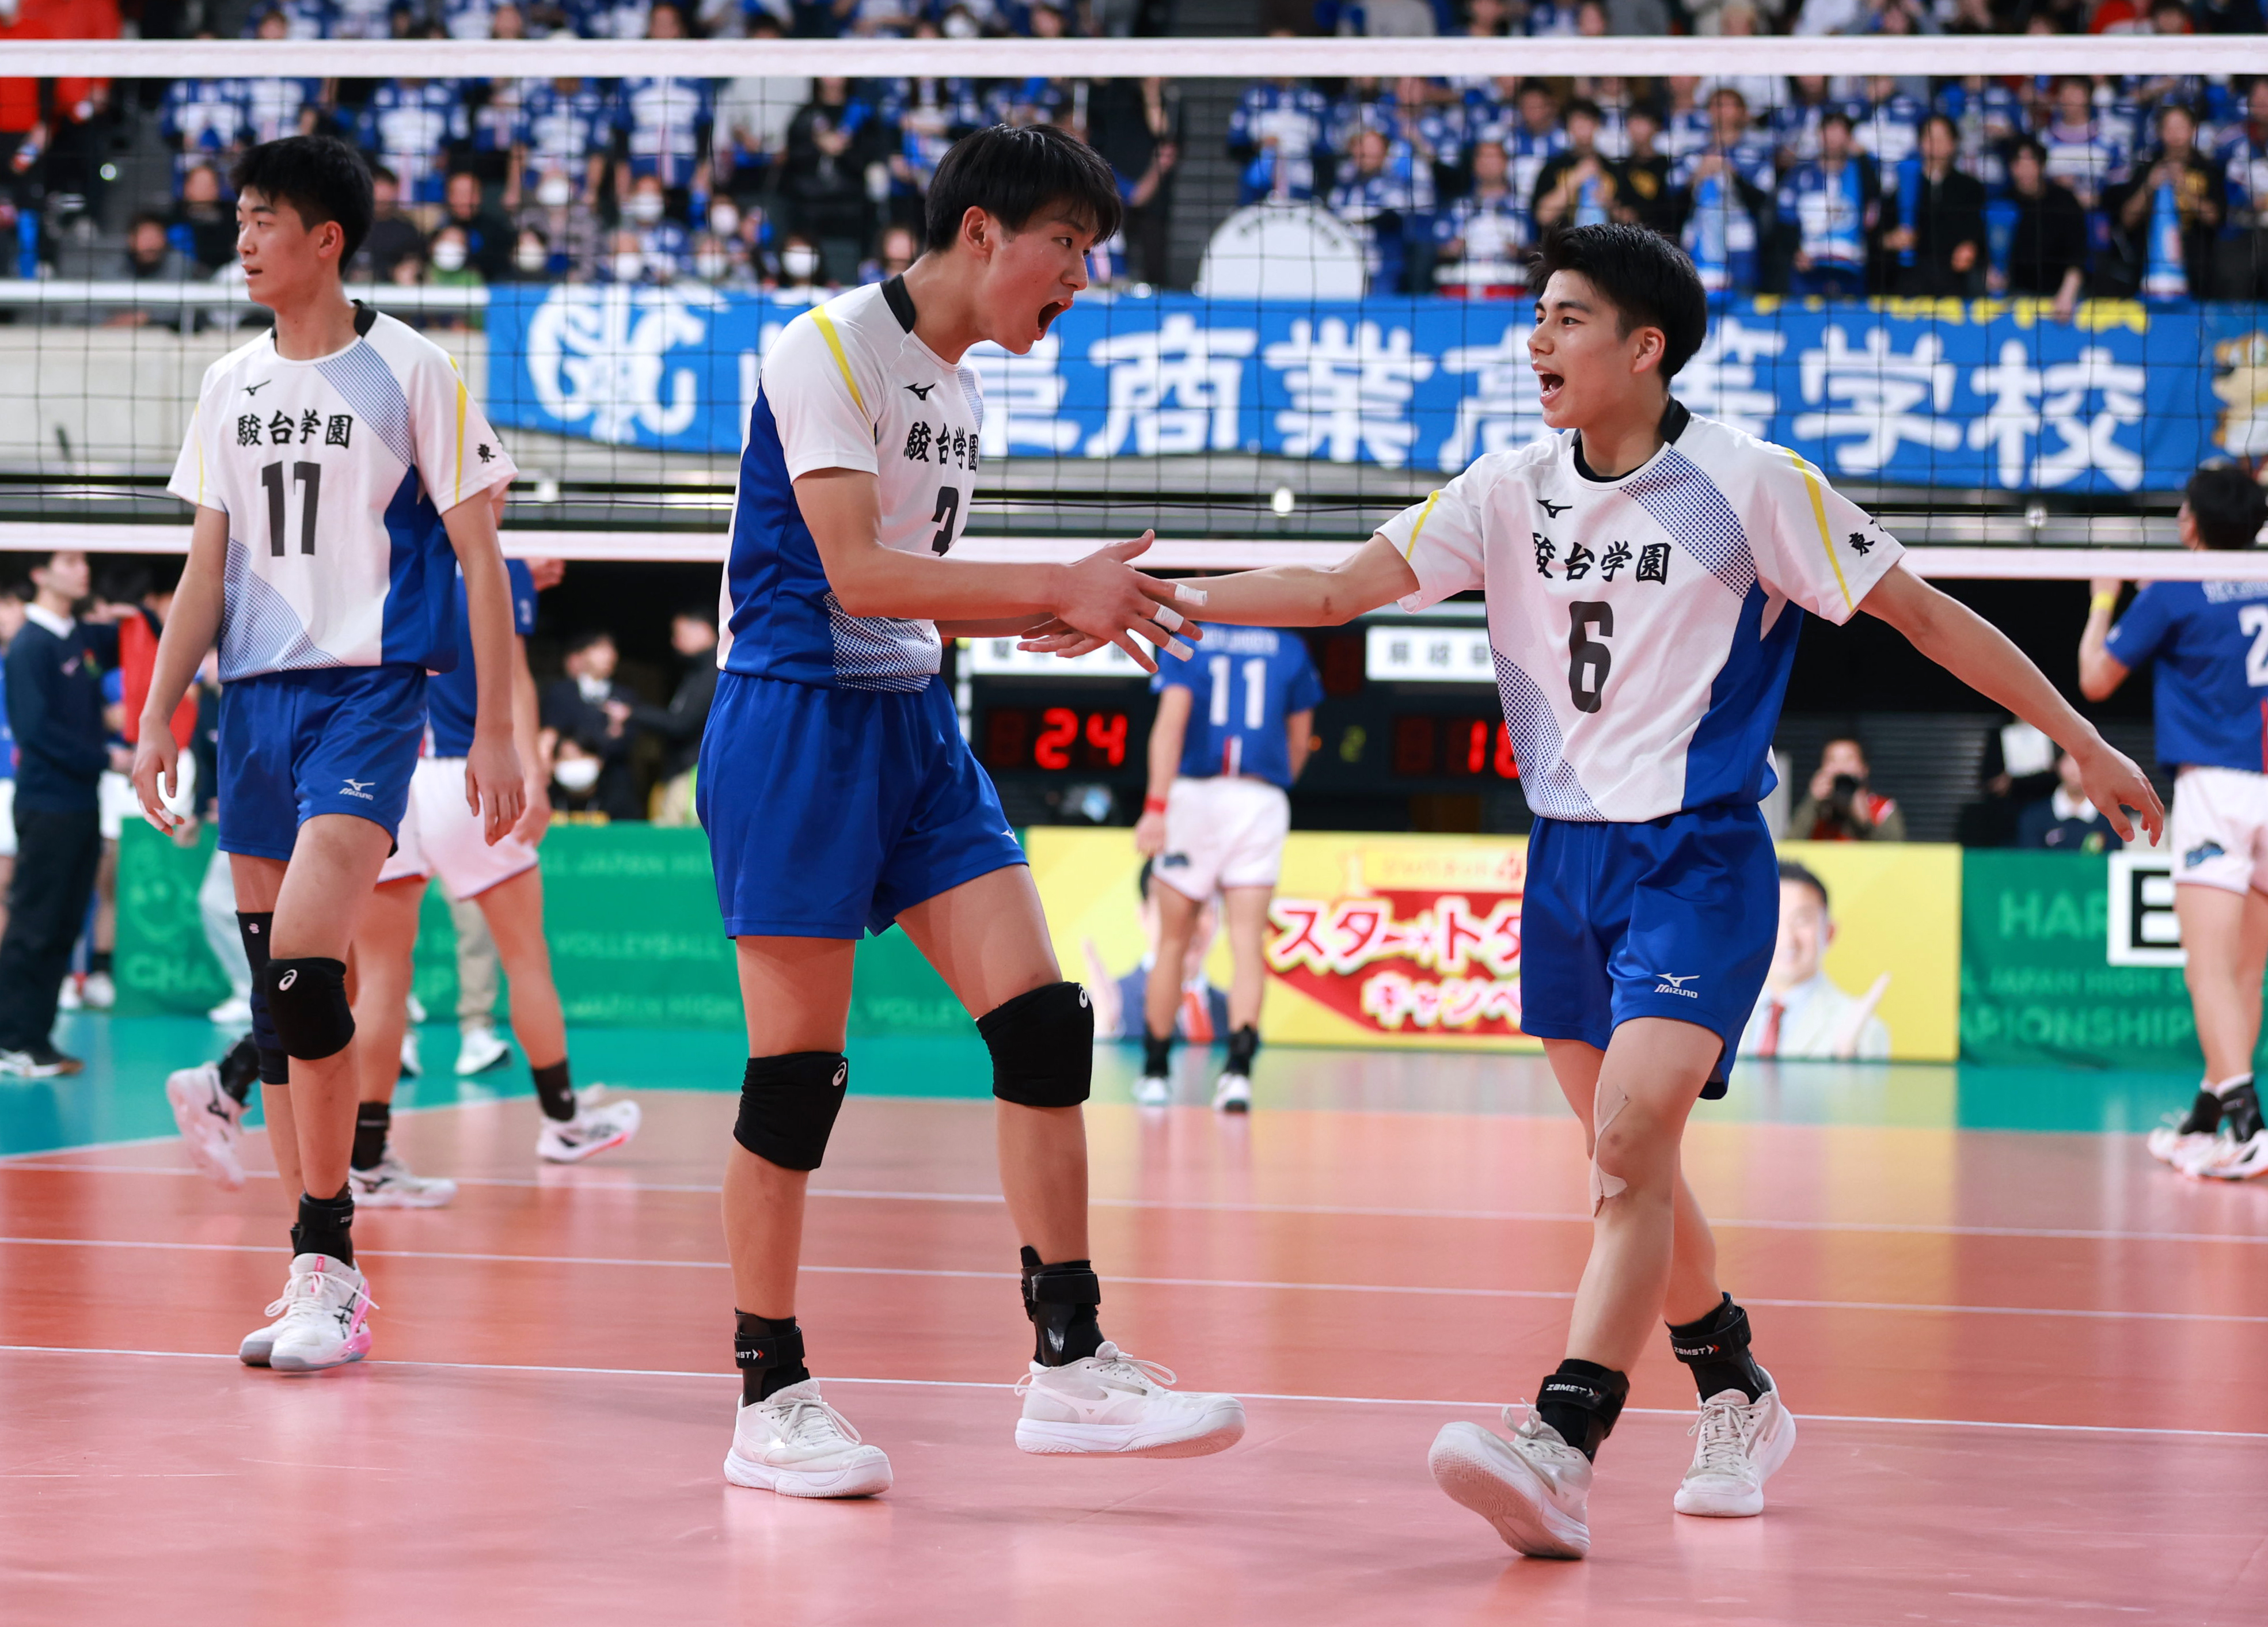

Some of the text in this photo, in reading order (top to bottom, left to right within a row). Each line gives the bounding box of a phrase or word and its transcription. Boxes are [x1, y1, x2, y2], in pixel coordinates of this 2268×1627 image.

[237, 409, 354, 448] 駿台学園
[904, 421, 978, 472] 駿台学園
[261, 461, 321, 557] 17
[1568, 601, 1613, 713] 6
[1209, 655, 1267, 729] 11
[1035, 708, 1127, 770] 24
